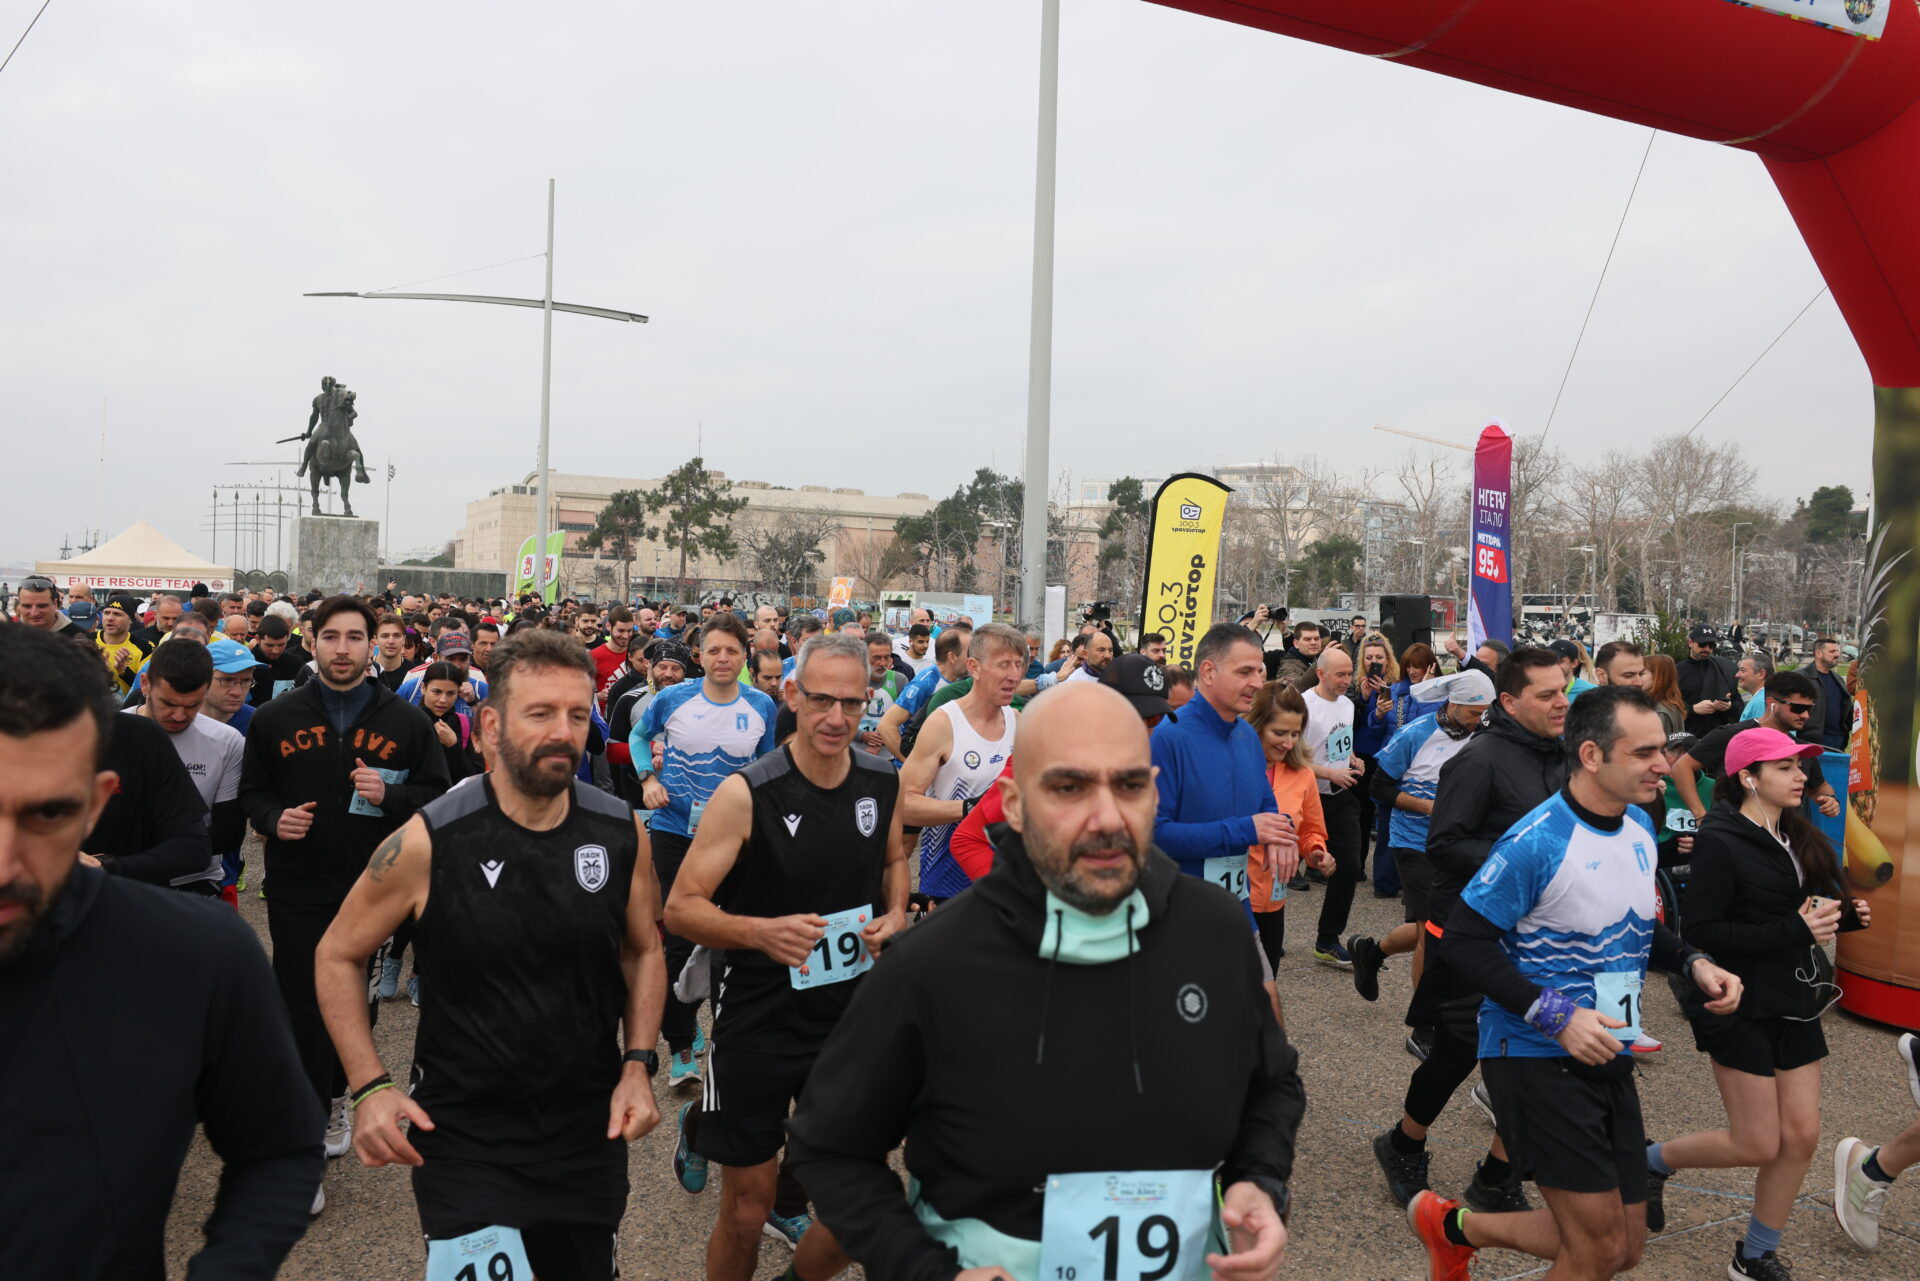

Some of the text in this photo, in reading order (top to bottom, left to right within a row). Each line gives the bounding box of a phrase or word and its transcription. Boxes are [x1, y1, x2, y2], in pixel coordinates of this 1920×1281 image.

[68, 576, 105, 587] ELITE
[109, 577, 162, 588] RESCUE
[1157, 581, 1184, 659] 100.3
[1179, 553, 1206, 672] ρανζίστορ
[280, 725, 397, 760] ACT IVE
[1335, 735, 1351, 754] 19
[357, 798, 366, 806] 10
[1677, 817, 1698, 829] 19
[1219, 869, 1245, 895] 19
[812, 931, 861, 972] 19
[1618, 992, 1641, 1028] 1
[1088, 1214, 1180, 1281] 19
[454, 1252, 514, 1281] 19
[1055, 1266, 1077, 1281] 10
